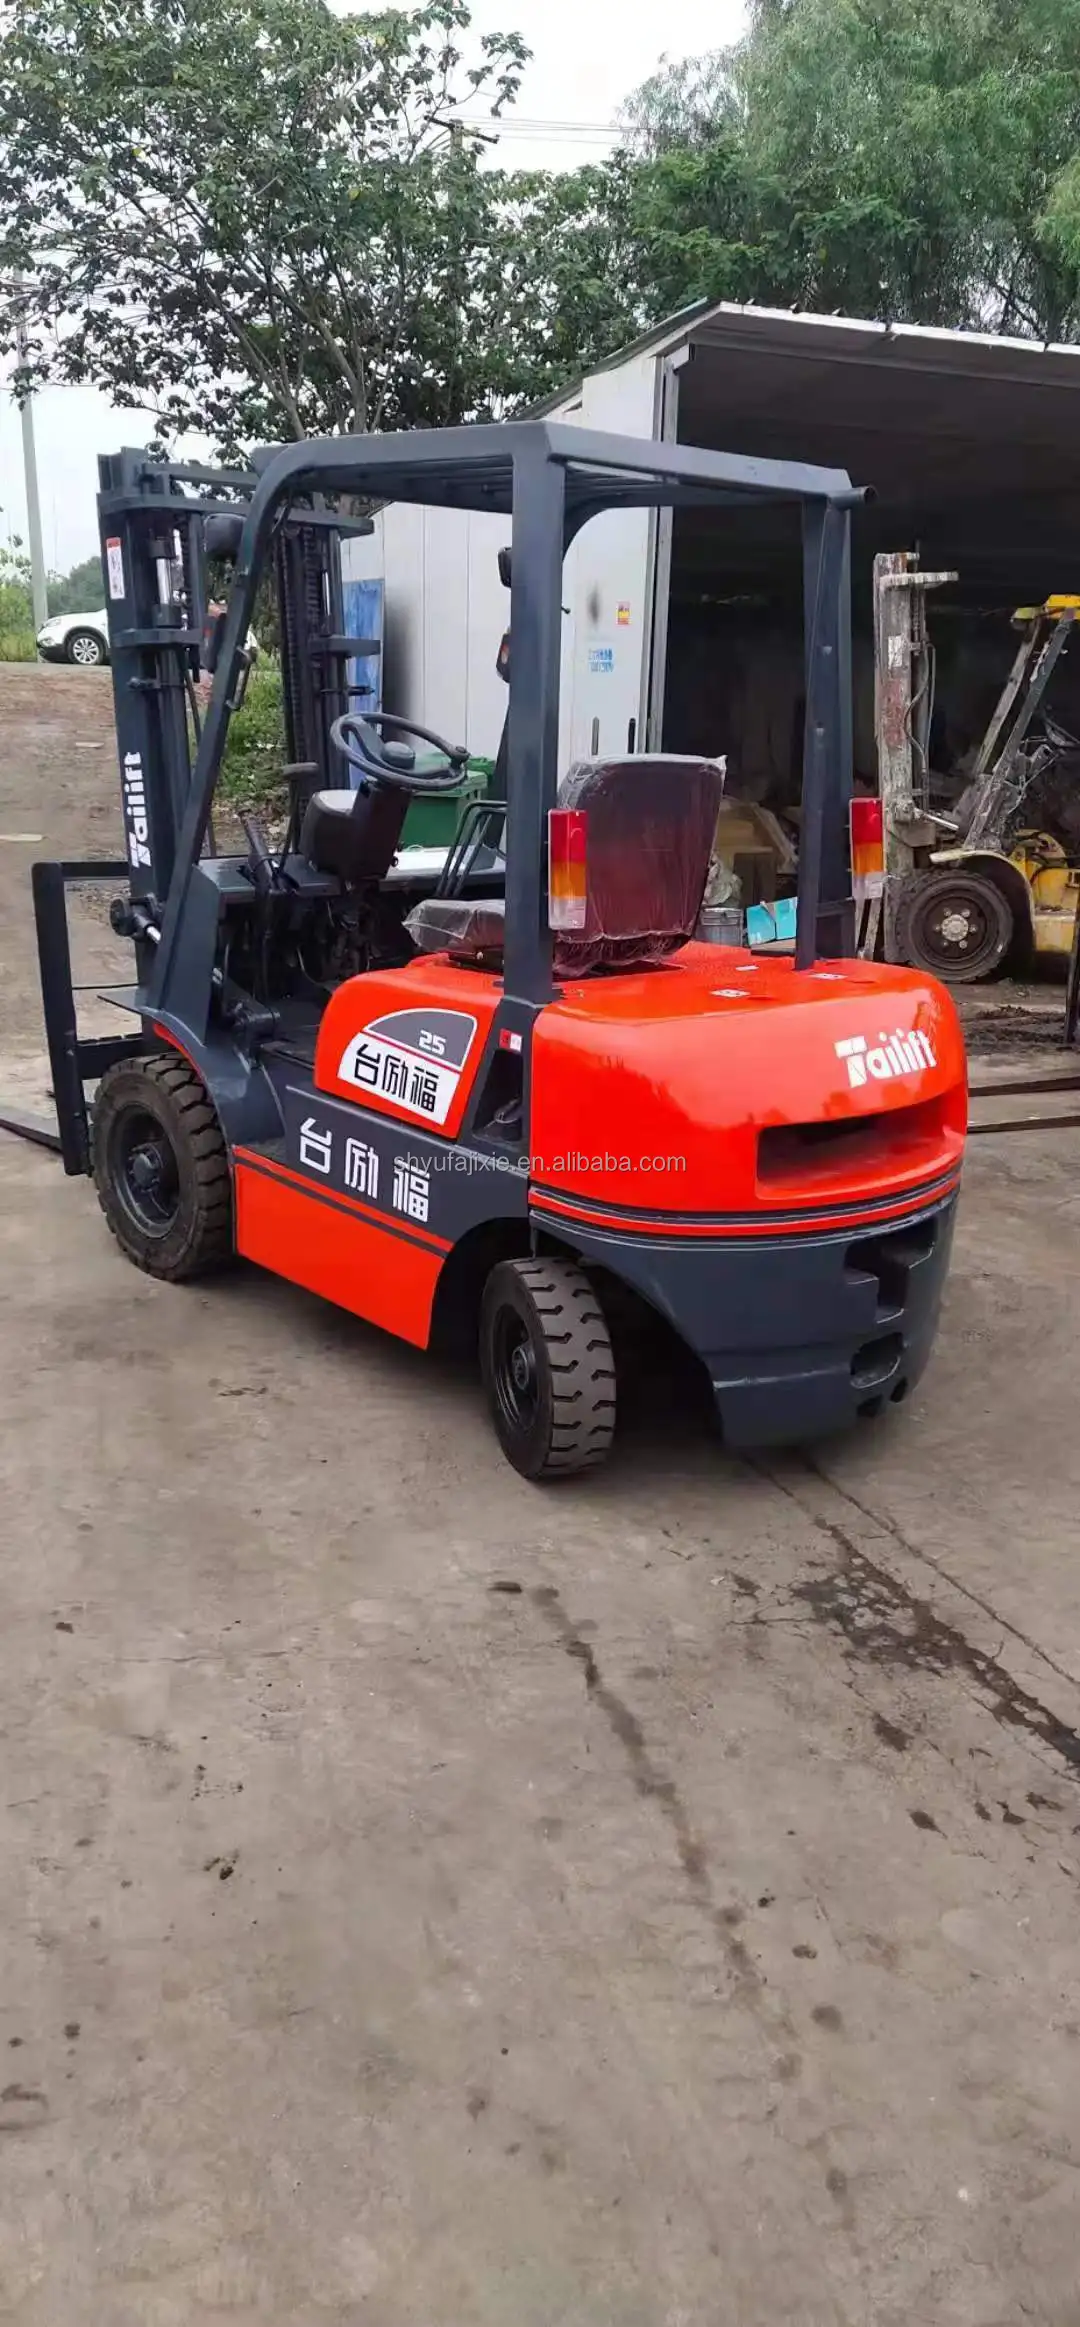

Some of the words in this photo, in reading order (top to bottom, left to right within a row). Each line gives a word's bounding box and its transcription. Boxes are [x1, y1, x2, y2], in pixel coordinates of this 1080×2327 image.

[124, 752, 152, 868] Tailift
[419, 1029, 446, 1056] 25
[834, 1027, 937, 1089] Tailift
[354, 1043, 440, 1113] 台励福
[300, 1117, 430, 1222] 台励福
